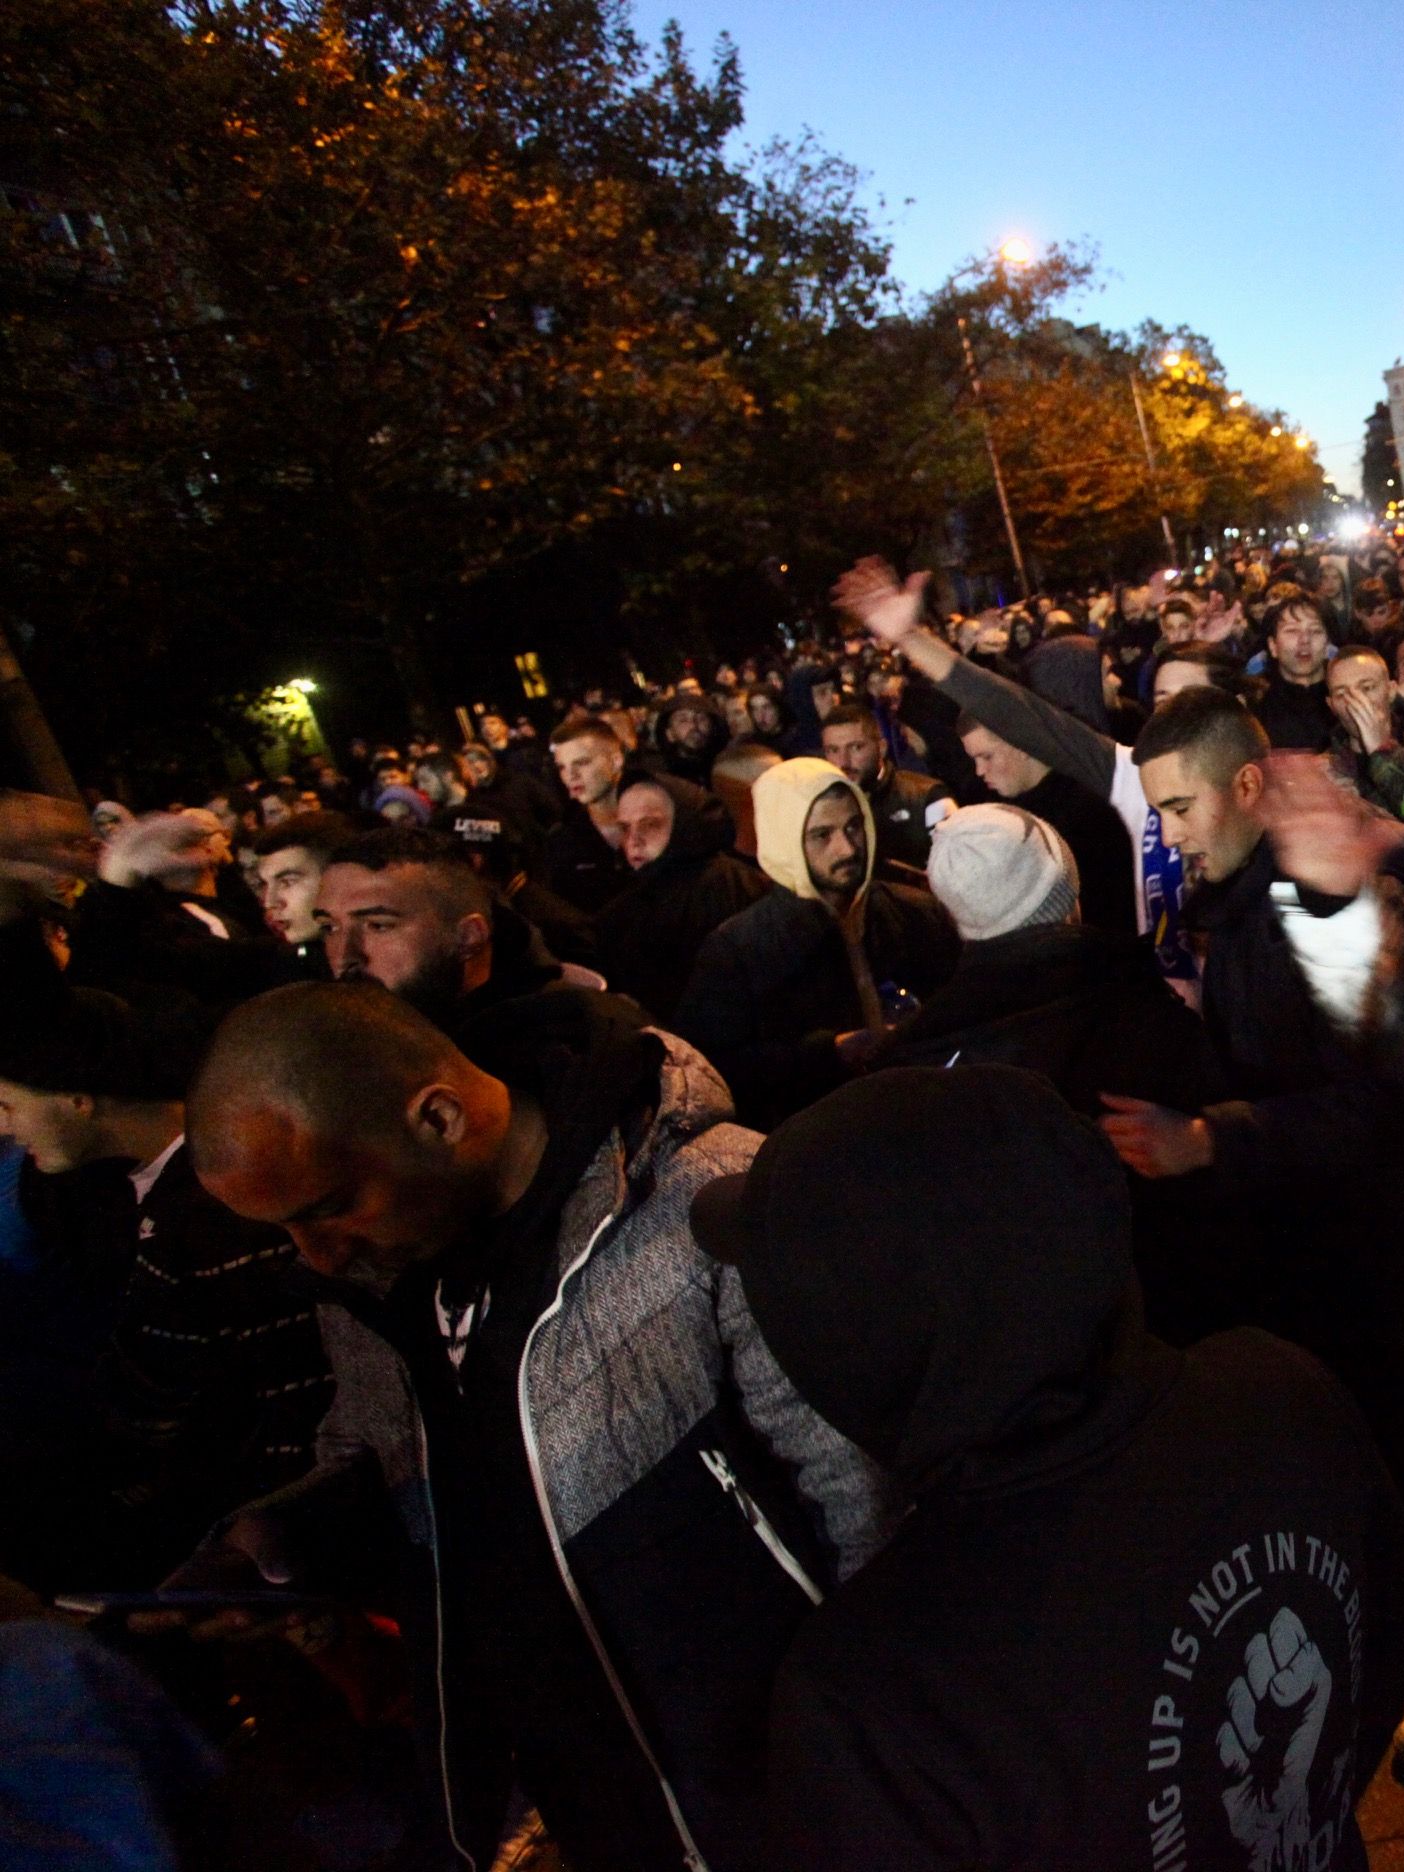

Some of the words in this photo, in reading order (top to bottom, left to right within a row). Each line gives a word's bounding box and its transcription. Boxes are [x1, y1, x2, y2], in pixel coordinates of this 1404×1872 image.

[1189, 1543, 1254, 1627] NOT
[1264, 1532, 1296, 1573] IN
[1306, 1535, 1350, 1601] THE
[1163, 1627, 1199, 1681] IS
[1148, 1694, 1184, 1771] UP
[1148, 1784, 1187, 1872] ING
